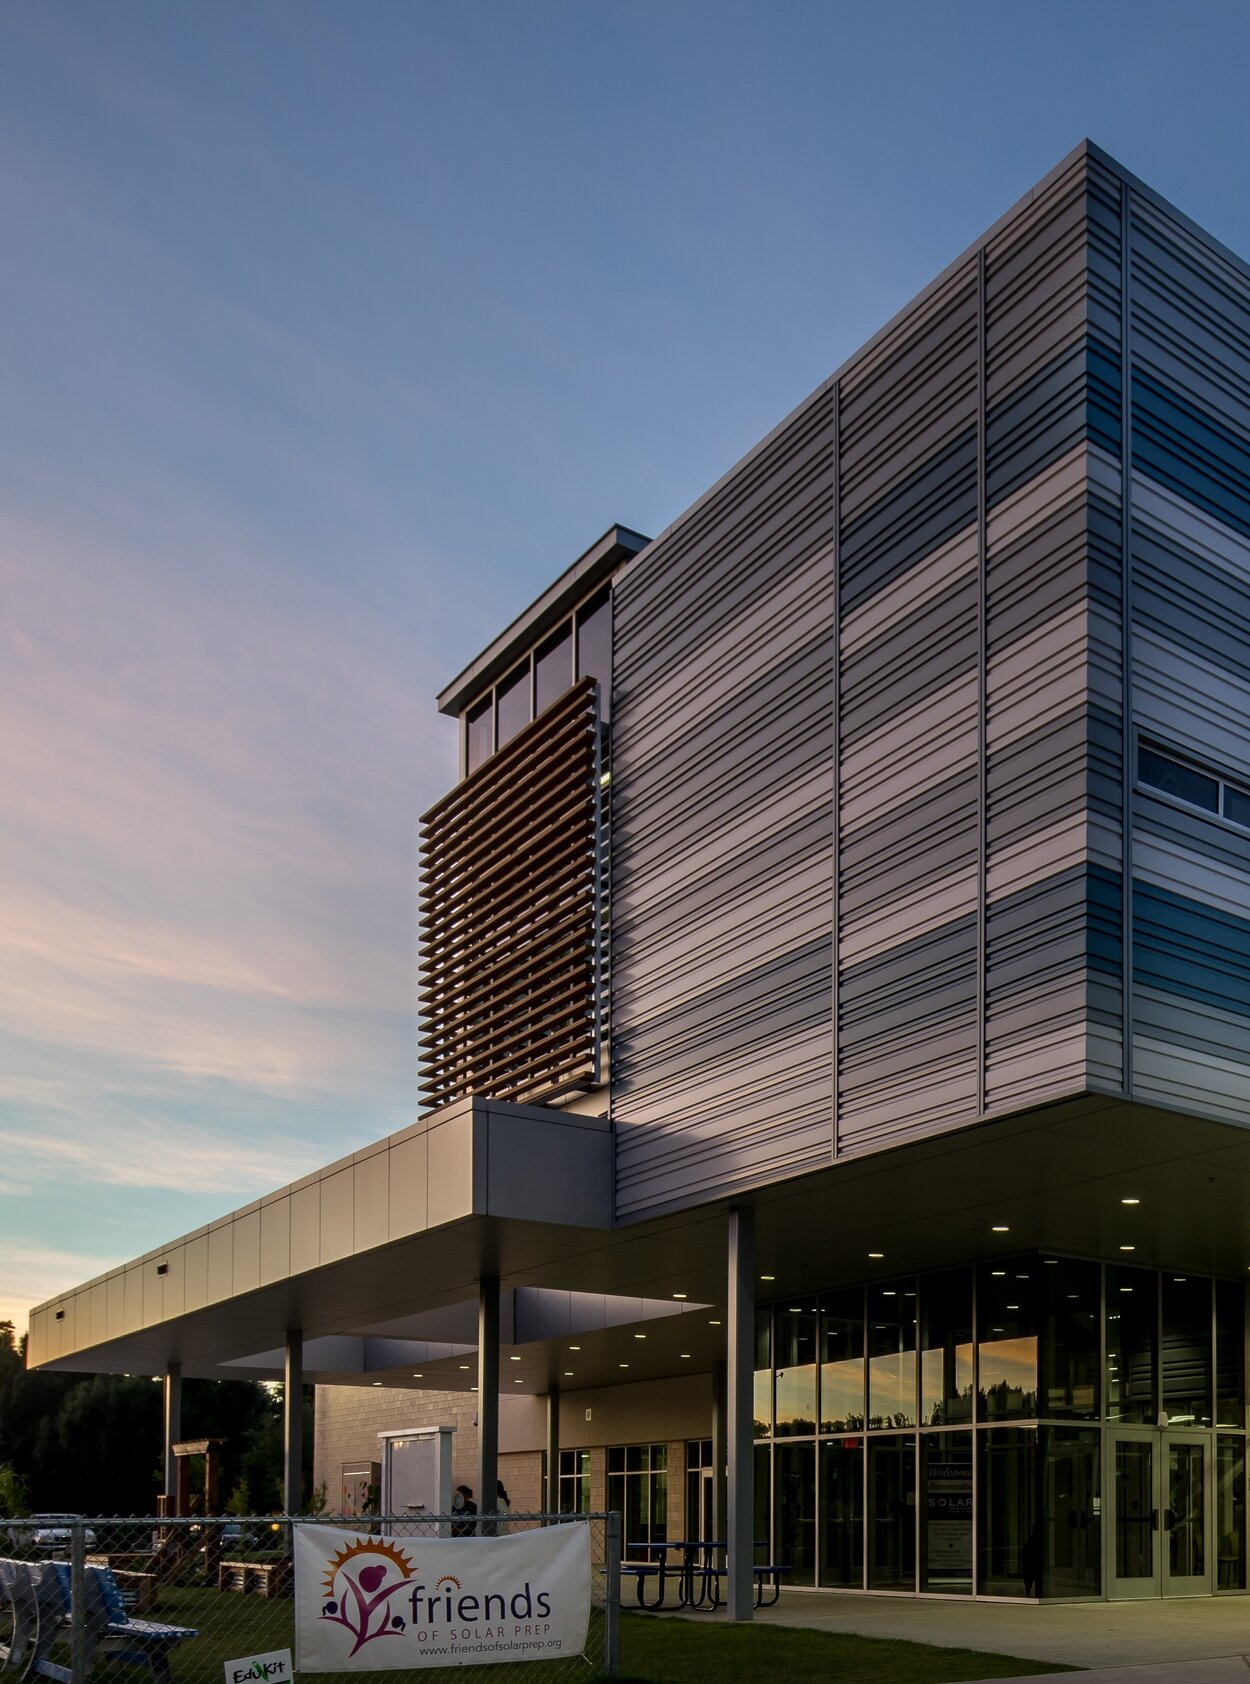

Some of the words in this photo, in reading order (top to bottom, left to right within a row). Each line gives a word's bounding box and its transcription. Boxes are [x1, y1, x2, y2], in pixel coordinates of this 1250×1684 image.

[408, 1582, 551, 1625] friends
[417, 1630, 439, 1642] OF
[450, 1627, 505, 1641] SOLAR
[514, 1624, 551, 1637] PREP
[419, 1638, 562, 1656] www.friendsofsolarprep.org
